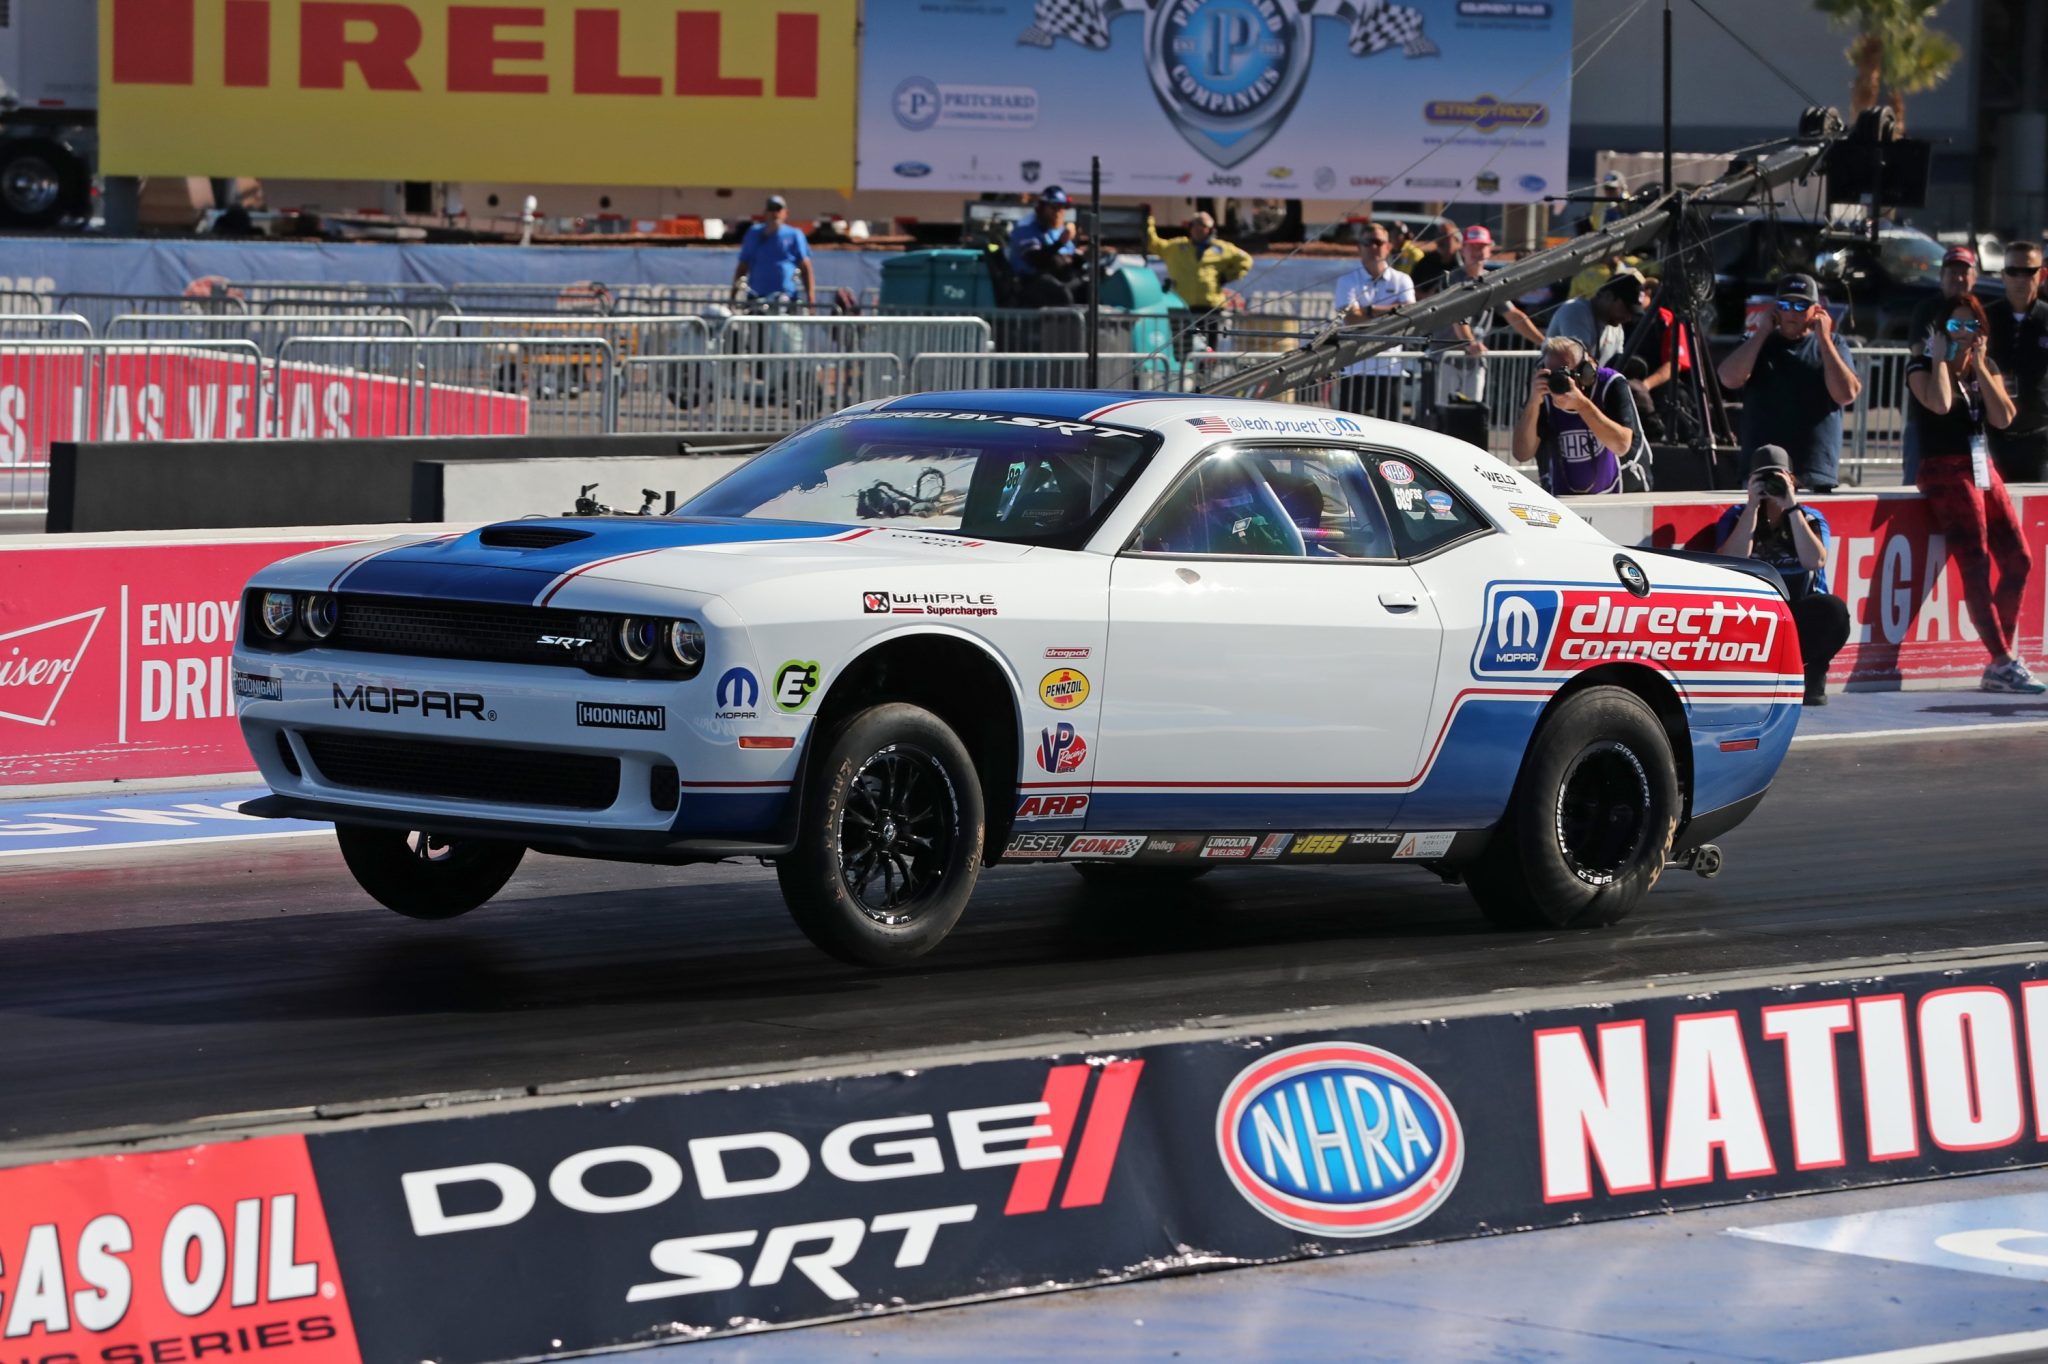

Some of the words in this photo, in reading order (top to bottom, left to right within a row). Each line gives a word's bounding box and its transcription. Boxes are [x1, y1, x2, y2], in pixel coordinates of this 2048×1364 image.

[1172, 65, 1280, 111] COMPANIES
[995, 416, 1143, 438] SRT
[1227, 416, 1321, 435] @leah.pruett
[892, 593, 995, 605] WHIPPLE
[1822, 534, 1984, 645] EGA
[926, 605, 998, 617] Superchargers
[1569, 597, 1756, 634] direct
[142, 601, 239, 646] ENJOY
[536, 635, 593, 649] SRT
[1560, 637, 1777, 662] connection
[1496, 653, 1536, 662] MOPAR
[1046, 681, 1082, 697] PENNZOIL
[333, 682, 486, 721] MOPAR
[1042, 723, 1075, 773] VP
[1018, 796, 1088, 816] ARP
[1008, 834, 1065, 852] JESEL
[1069, 839, 1128, 852] COMP
[1148, 841, 1176, 852] Holley
[1208, 838, 1247, 847] LINCOLN
[1297, 836, 1348, 853] JEGS
[1351, 833, 1401, 843] DAYCO
[1212, 848, 1246, 856] WELDERS
[1250, 1074, 1434, 1194] NHRA
[402, 1101, 1064, 1237] DODGE
[626, 1204, 978, 1302] SRT
[0, 1222, 133, 1339] AS
[161, 1193, 320, 1318] OIL
[101, 1315, 337, 1364] SERIES
